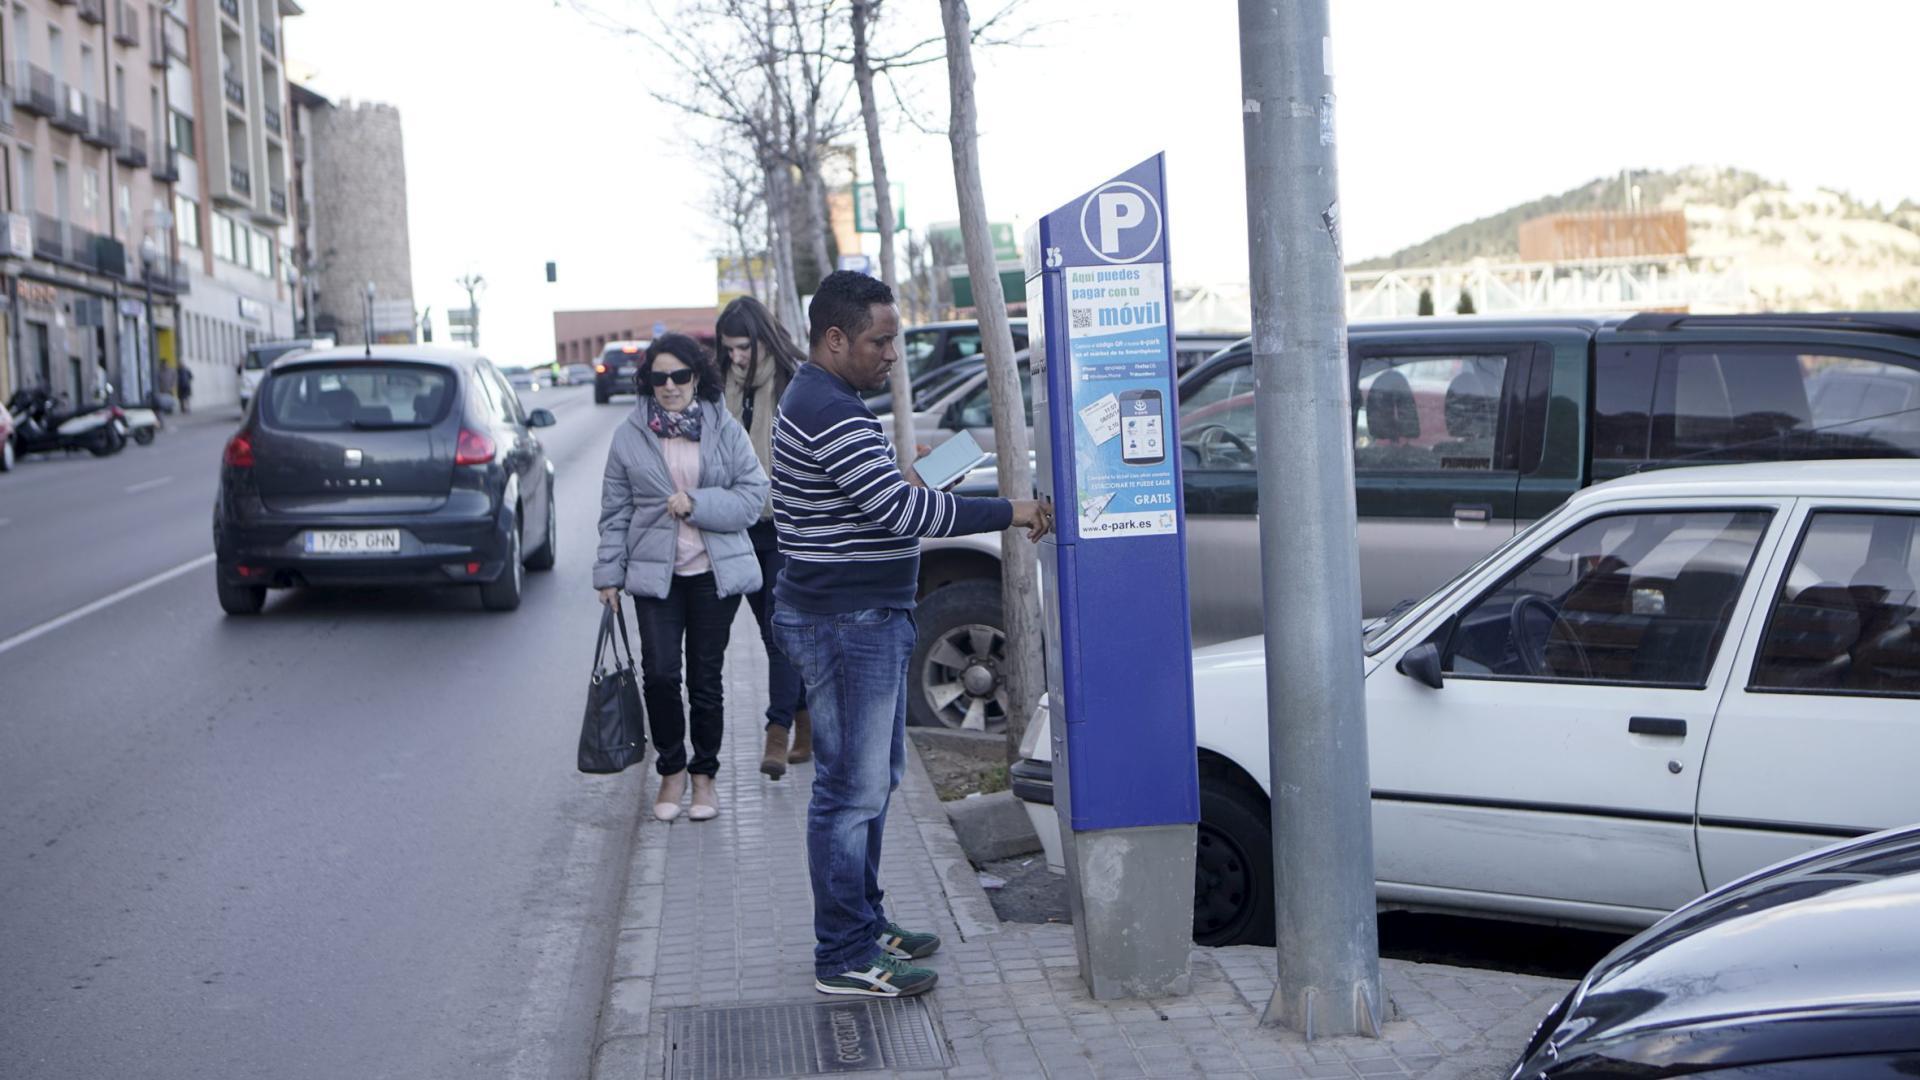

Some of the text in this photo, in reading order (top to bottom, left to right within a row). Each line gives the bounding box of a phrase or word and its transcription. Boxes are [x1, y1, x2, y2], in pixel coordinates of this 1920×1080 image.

[1099, 192, 1145, 254] P
[1097, 269, 1140, 282] puedes
[1072, 287, 1105, 300] pagar
[1108, 288, 1127, 297] con
[1134, 493, 1171, 505] GRATIS
[1083, 519, 1152, 532] www.e-park.es
[320, 532, 395, 548] 1785 GHN
